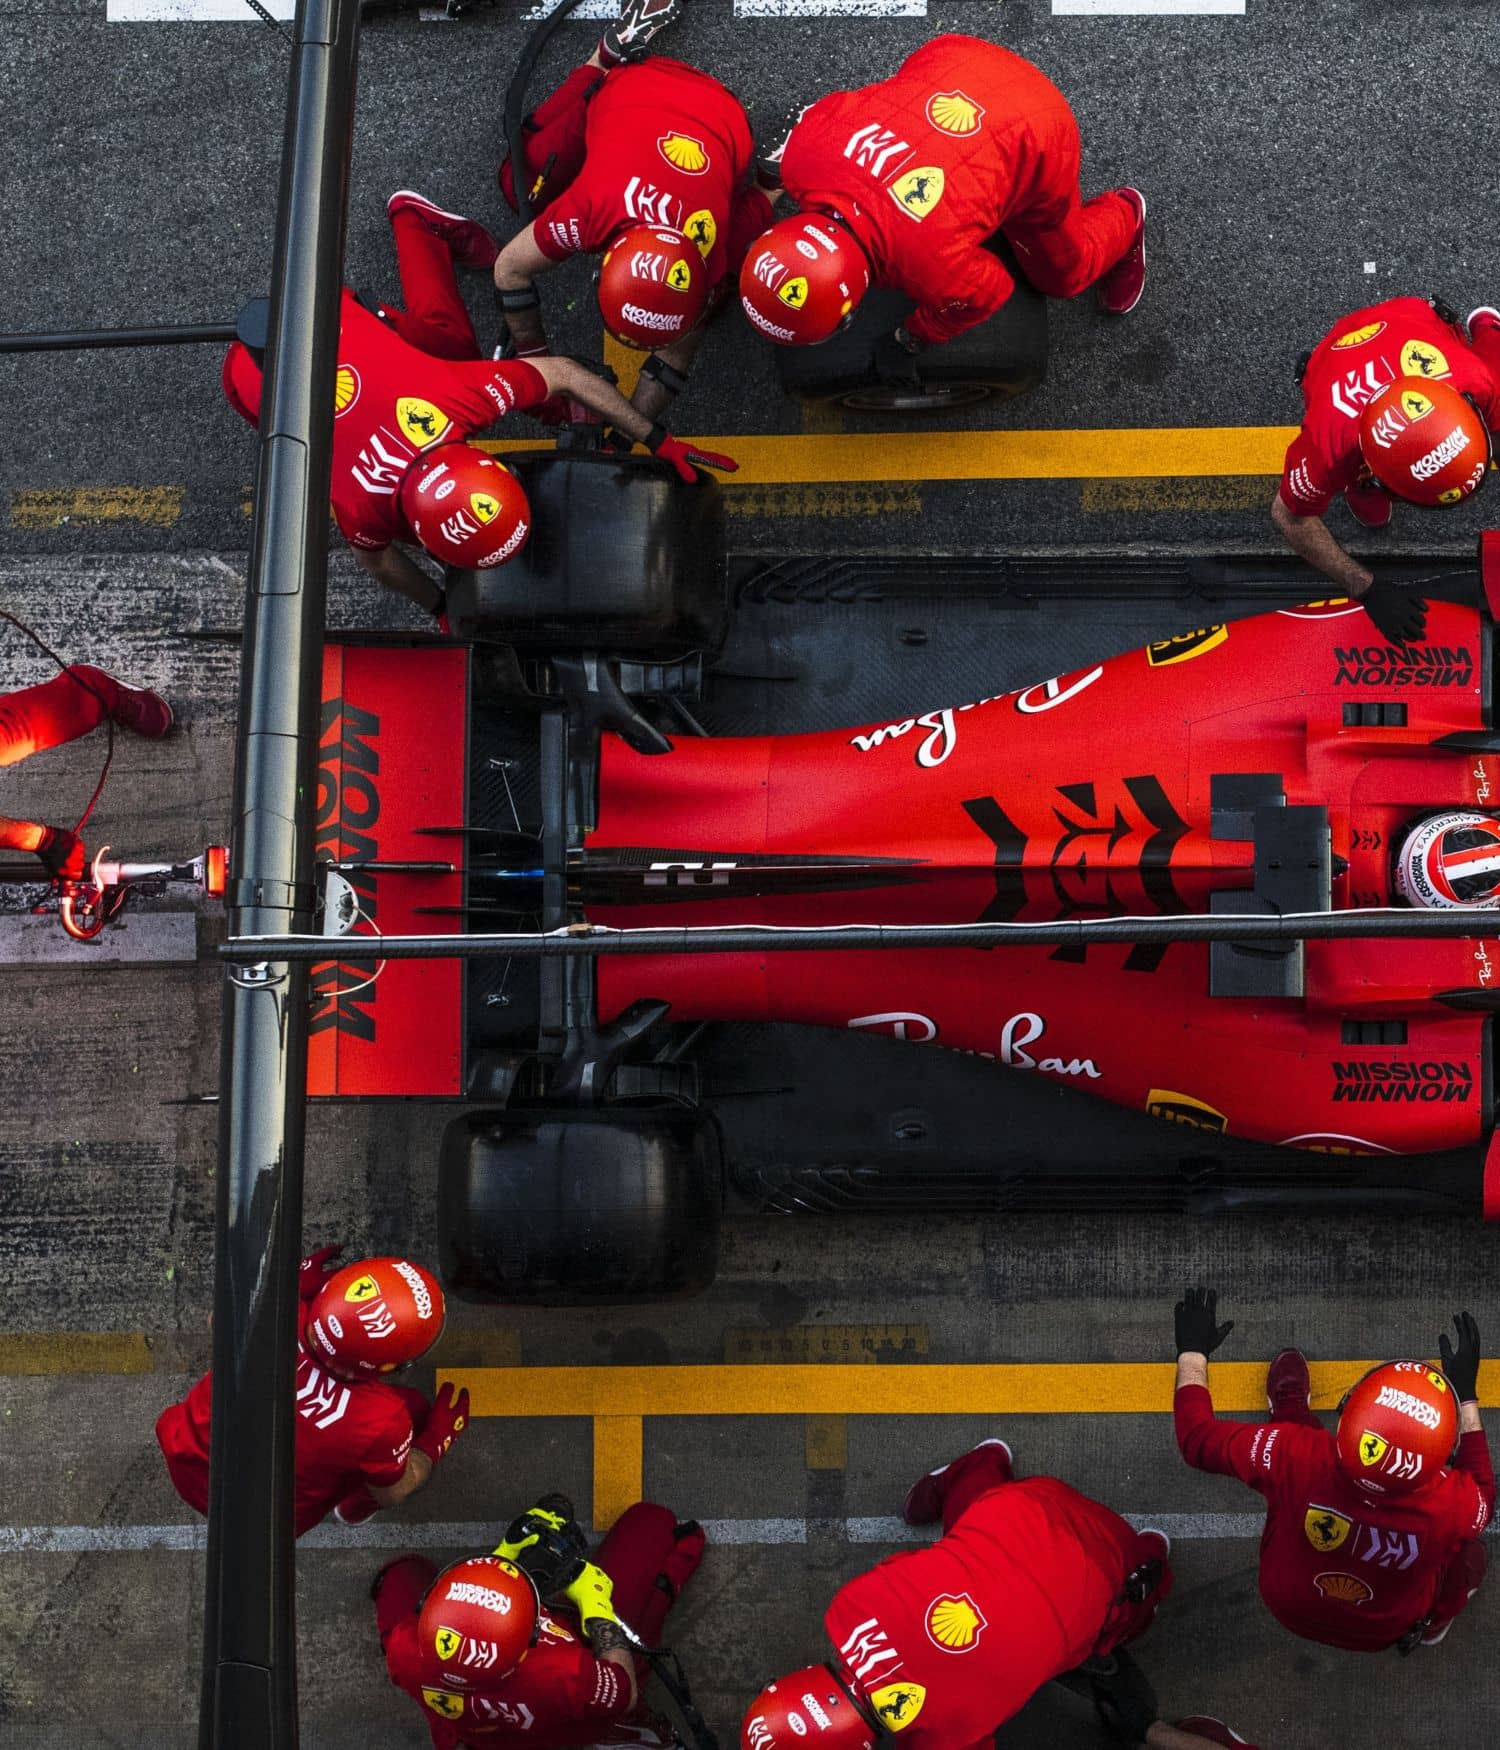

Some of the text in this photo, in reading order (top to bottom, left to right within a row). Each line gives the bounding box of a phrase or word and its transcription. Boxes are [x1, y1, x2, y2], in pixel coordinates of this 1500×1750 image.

[1332, 1061, 1473, 1083] MISSION
[328, 1316, 342, 1337] BELL
[1262, 1428, 1280, 1470] HUBLOT
